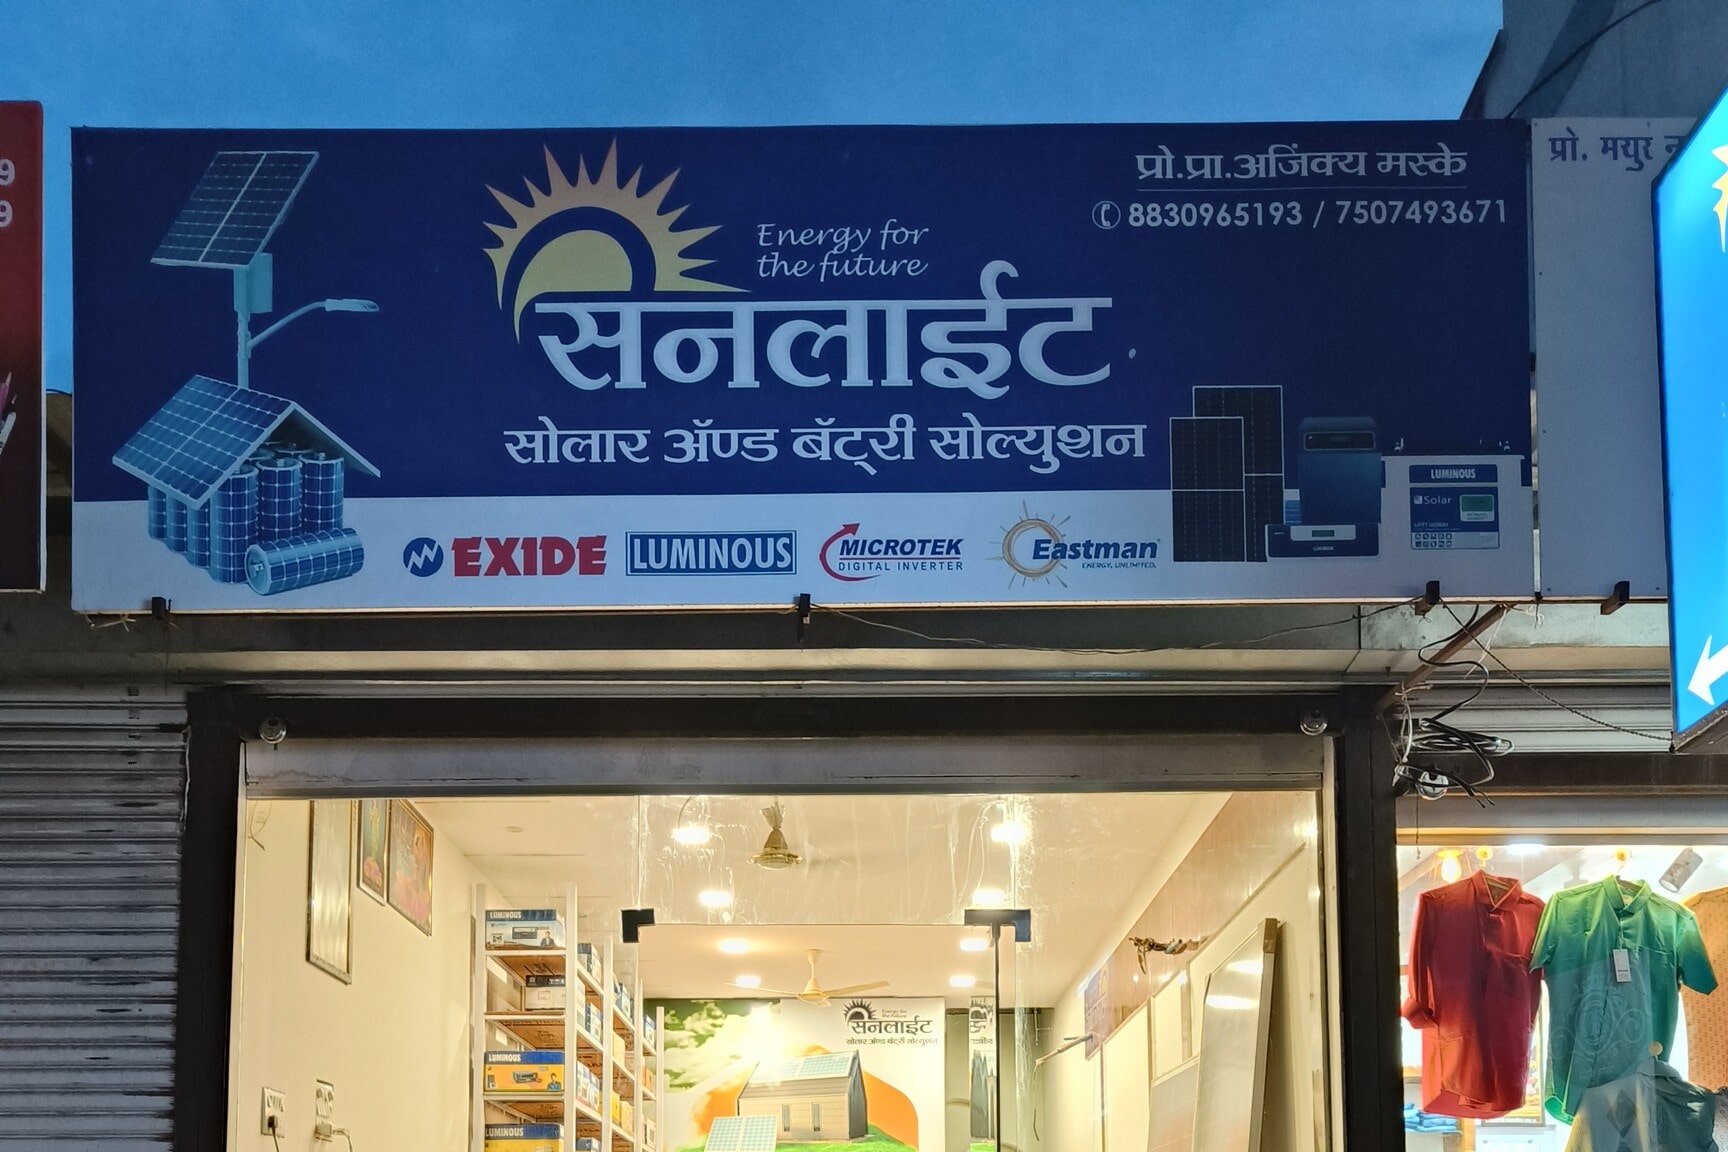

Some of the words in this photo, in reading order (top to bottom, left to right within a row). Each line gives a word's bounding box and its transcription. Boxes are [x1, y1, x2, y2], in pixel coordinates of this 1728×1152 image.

[1548, 126, 1588, 161] प्रो.
[1377, 142, 1468, 179] मस्के
[1128, 201, 1303, 229] 8830965193
[1336, 198, 1508, 226] 7507493671
[758, 223, 871, 253] Energy
[879, 219, 929, 251] for
[757, 252, 816, 279] the
[818, 251, 929, 283] future
[534, 259, 1112, 400] सनलाईट
[504, 416, 650, 464] सोलार
[1430, 468, 1476, 480] LUMINOUS
[1423, 495, 1452, 505] Solar
[451, 535, 606, 577] EXIDE
[634, 536, 792, 570] LUMINOUS
[838, 537, 964, 556] MICROTEK
[1033, 539, 1158, 560] Eastman
[838, 561, 890, 572] DIGITAL
[897, 561, 964, 571] INVERTER
[489, 911, 522, 919] LUMINOUS
[851, 1015, 934, 1036] सनलाईट
[488, 1054, 522, 1063] LUMINOUS
[485, 1127, 524, 1138] LUMINOUS
